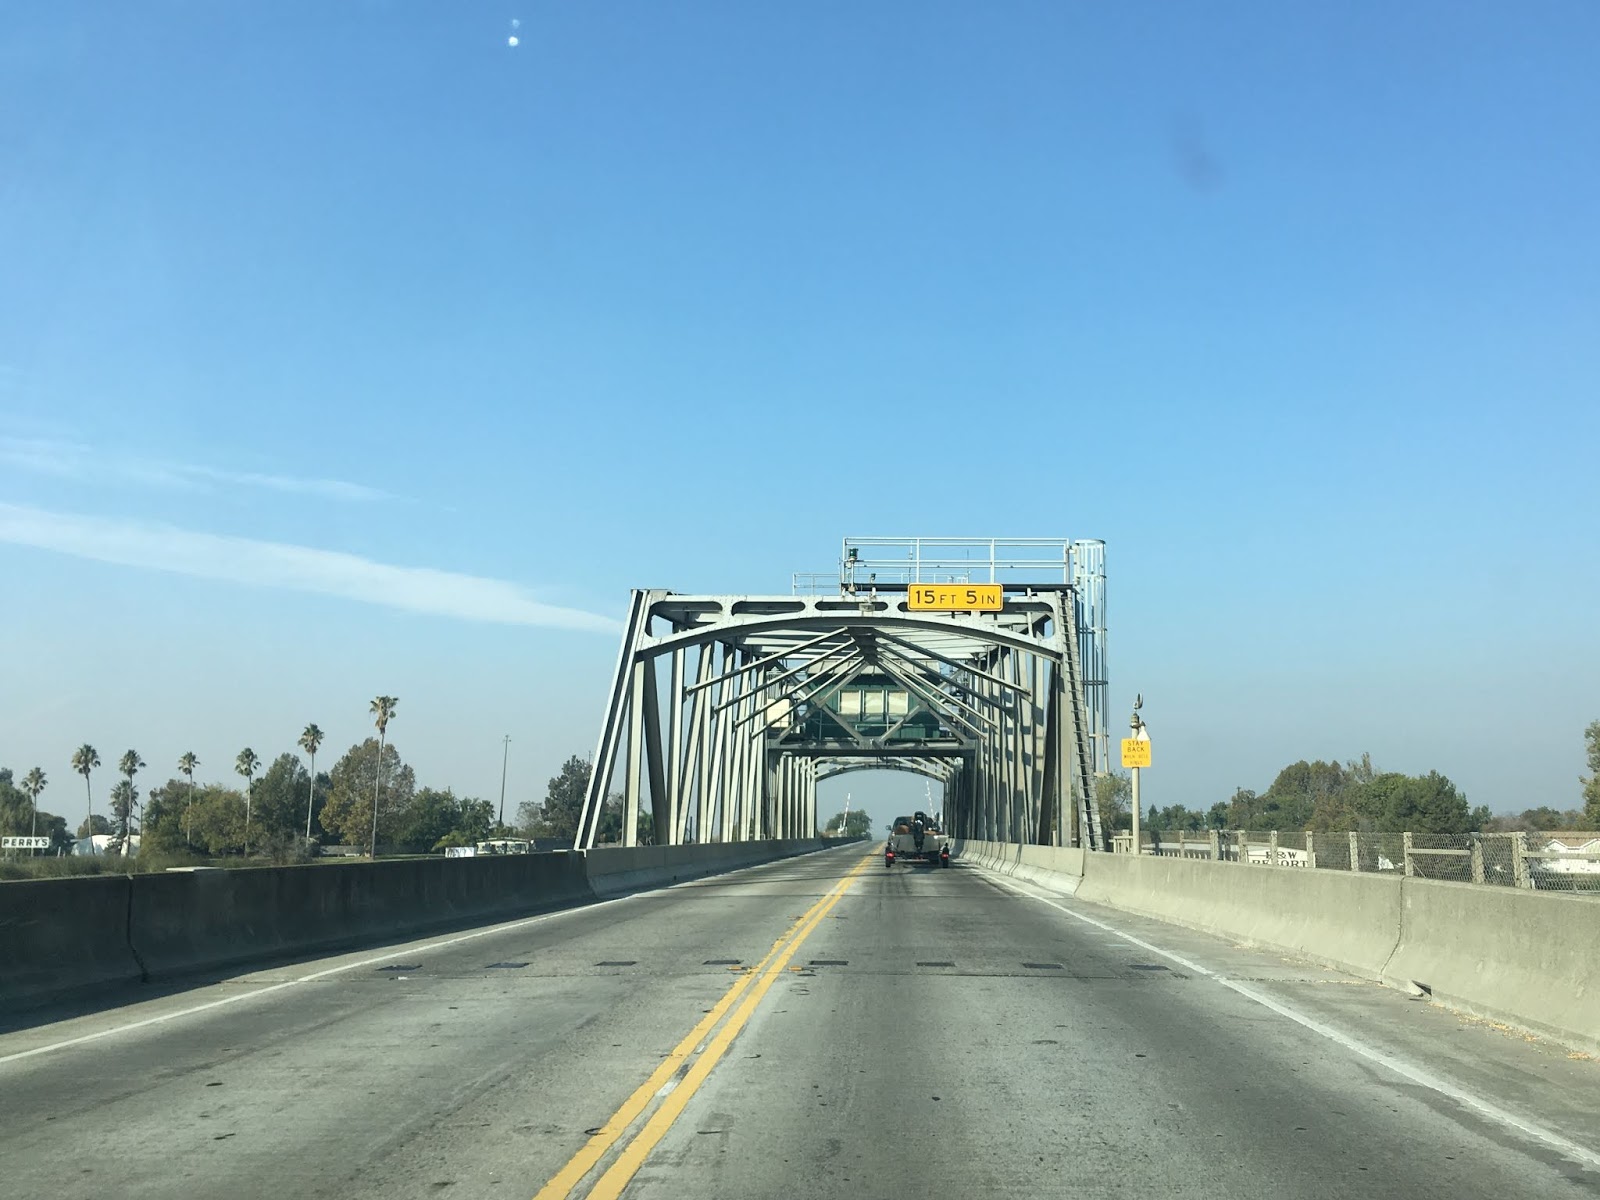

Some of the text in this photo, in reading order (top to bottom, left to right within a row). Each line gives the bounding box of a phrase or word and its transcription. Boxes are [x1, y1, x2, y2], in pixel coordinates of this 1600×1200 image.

[915, 590, 995, 604] 15 FT 5 IN
[3, 837, 48, 847] PERRY'S
[1252, 859, 1309, 868] REORT
